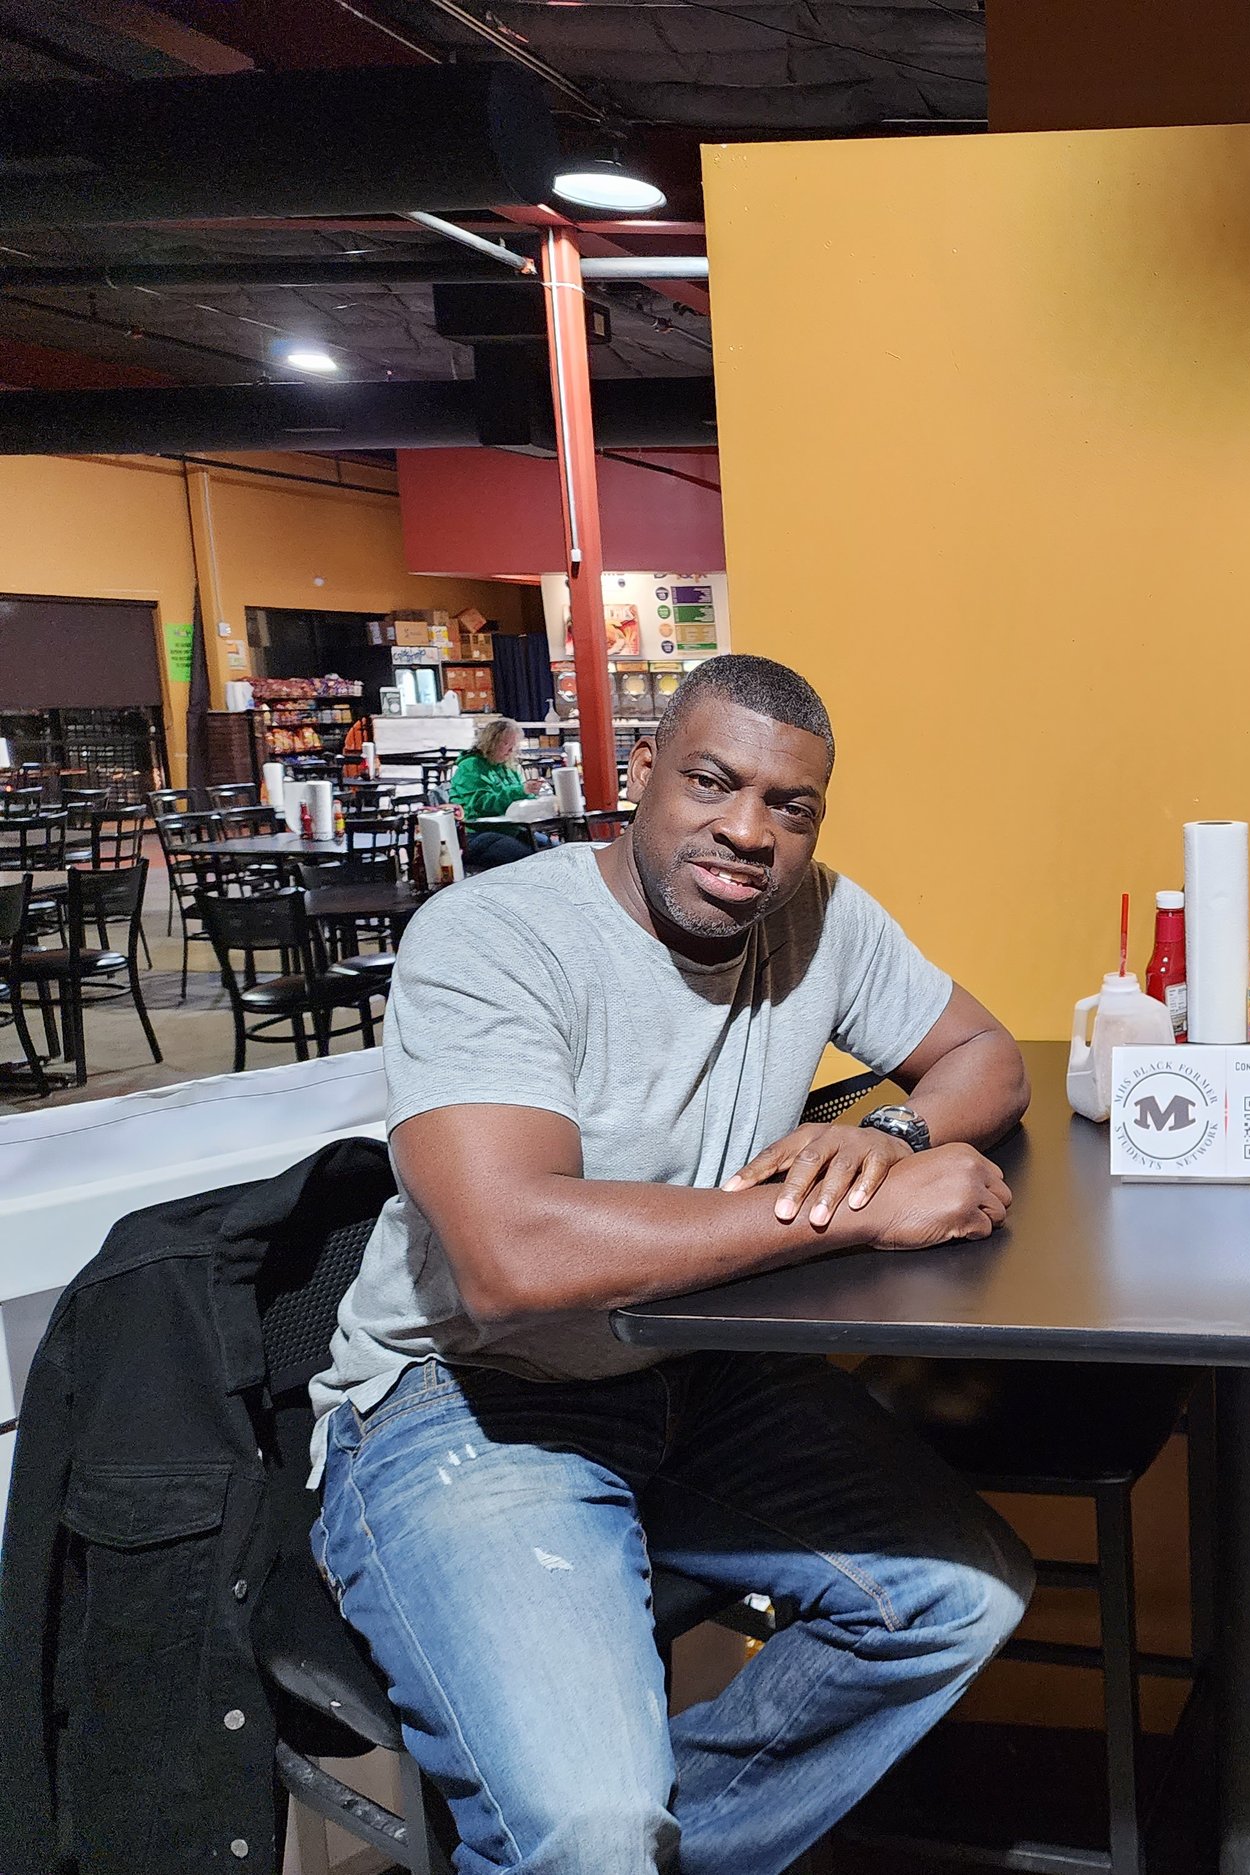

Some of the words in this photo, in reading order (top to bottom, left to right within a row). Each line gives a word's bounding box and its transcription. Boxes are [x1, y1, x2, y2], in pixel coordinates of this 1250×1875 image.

[1133, 1061, 1173, 1079] BLACK
[1179, 1064, 1218, 1104] FORMER
[1134, 1095, 1196, 1131] M
[1114, 1126, 1162, 1170] STUDENTS
[1176, 1123, 1218, 1168] NETWORK
